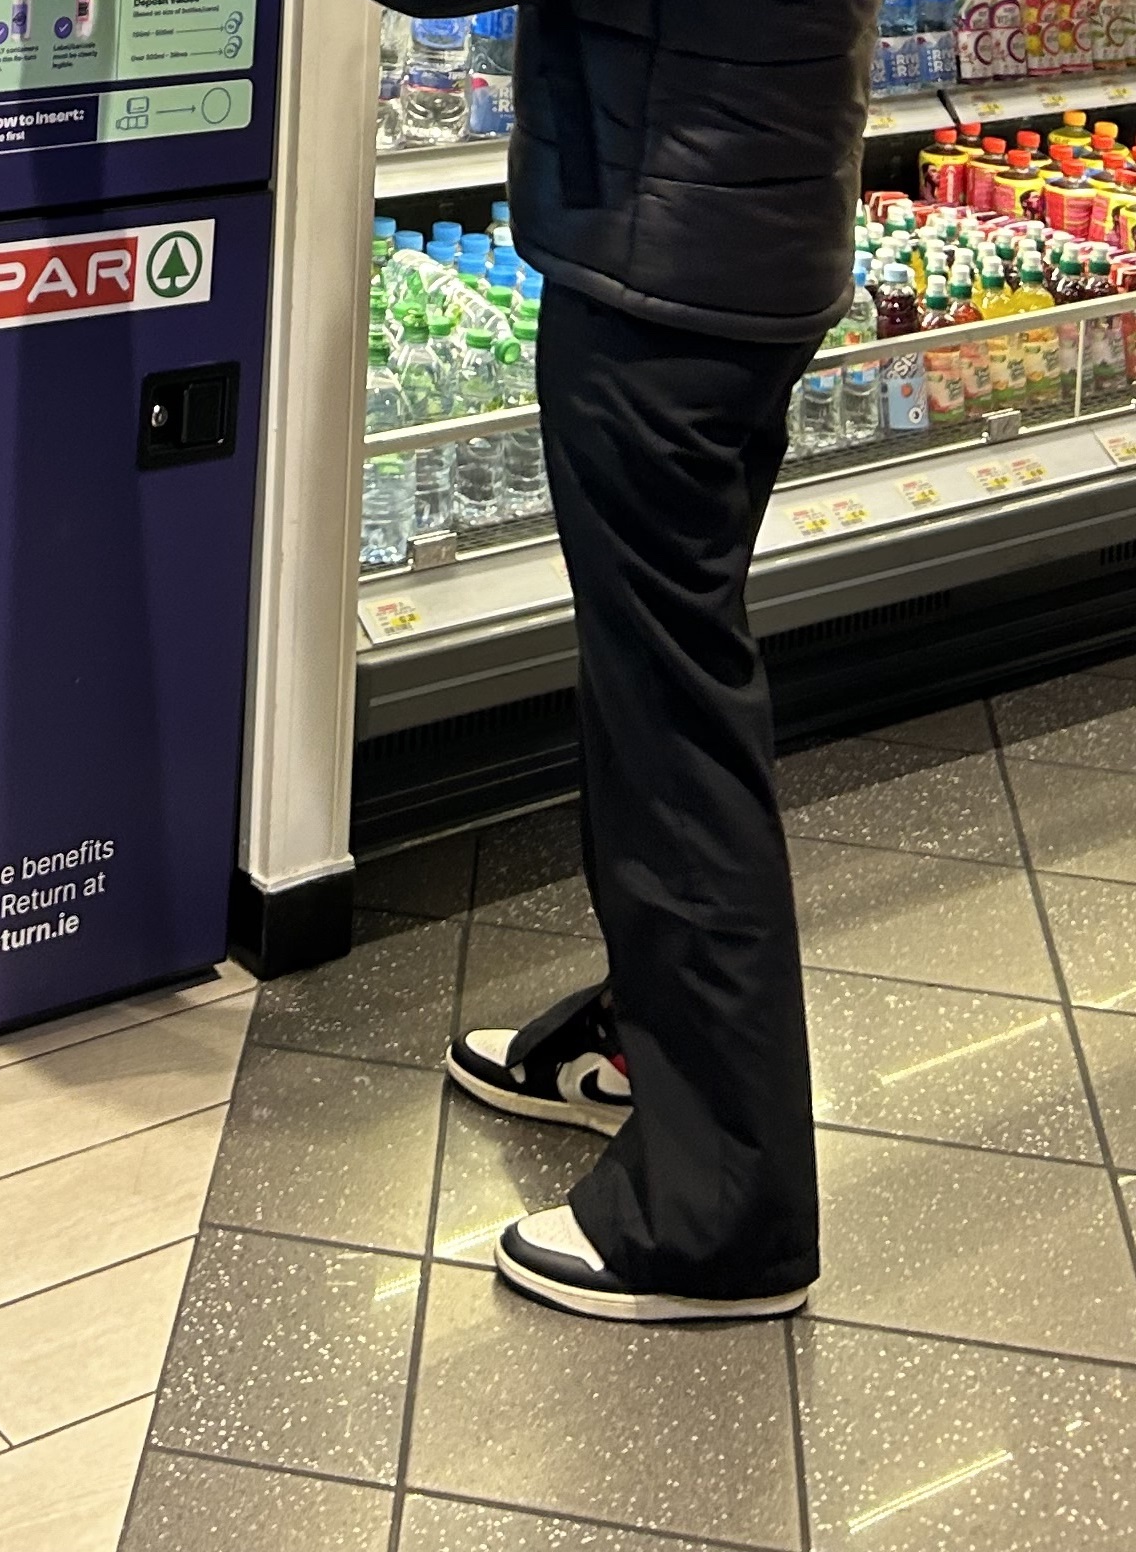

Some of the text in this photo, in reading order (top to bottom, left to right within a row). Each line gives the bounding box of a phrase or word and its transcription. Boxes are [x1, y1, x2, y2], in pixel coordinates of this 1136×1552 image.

[19, 114, 35, 126] to
[36, 109, 84, 125] Insert:
[6, 131, 25, 141] first
[21, 839, 114, 881] benefits
[0, 881, 76, 919] Return
[82, 870, 106, 897] at
